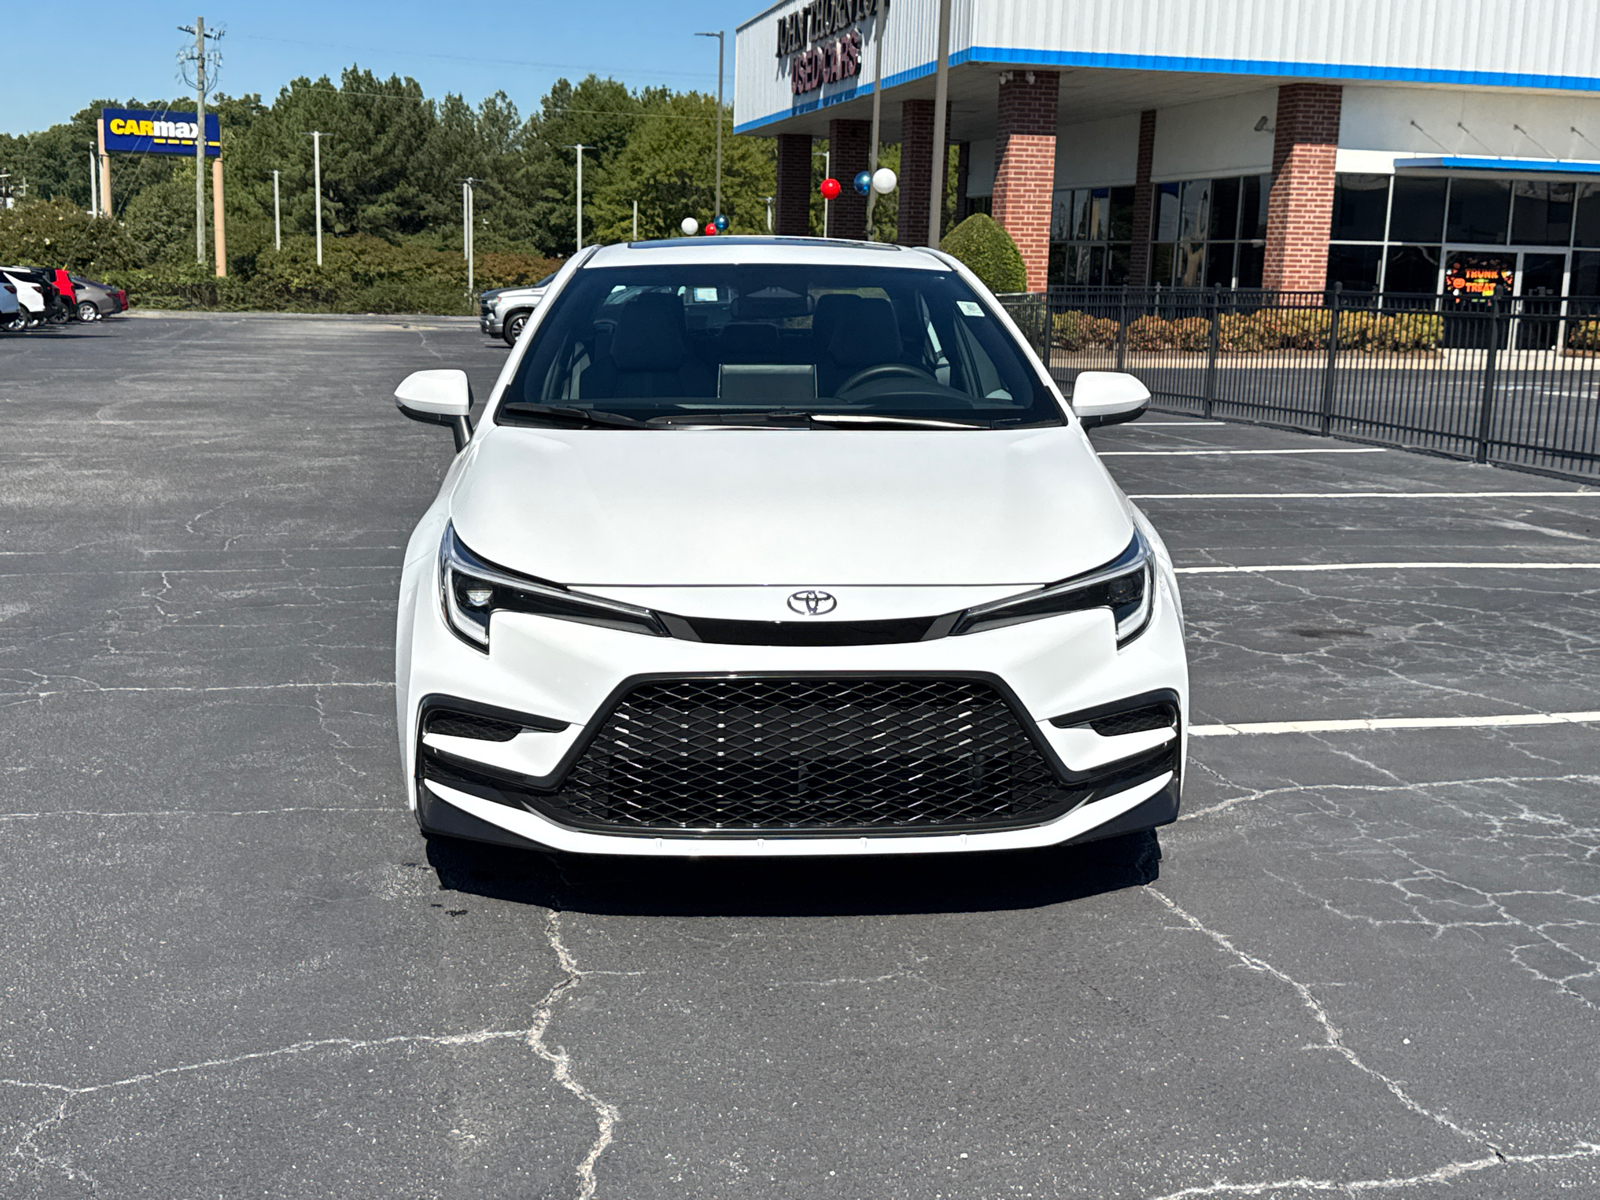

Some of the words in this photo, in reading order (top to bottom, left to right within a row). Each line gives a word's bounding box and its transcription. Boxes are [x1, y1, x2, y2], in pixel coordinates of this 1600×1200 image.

[775, 8, 810, 58] JOHN
[808, 0, 890, 43] THORN
[791, 47, 822, 95] USED
[822, 30, 861, 84] CARS
[1465, 282, 1497, 293] TREAT
